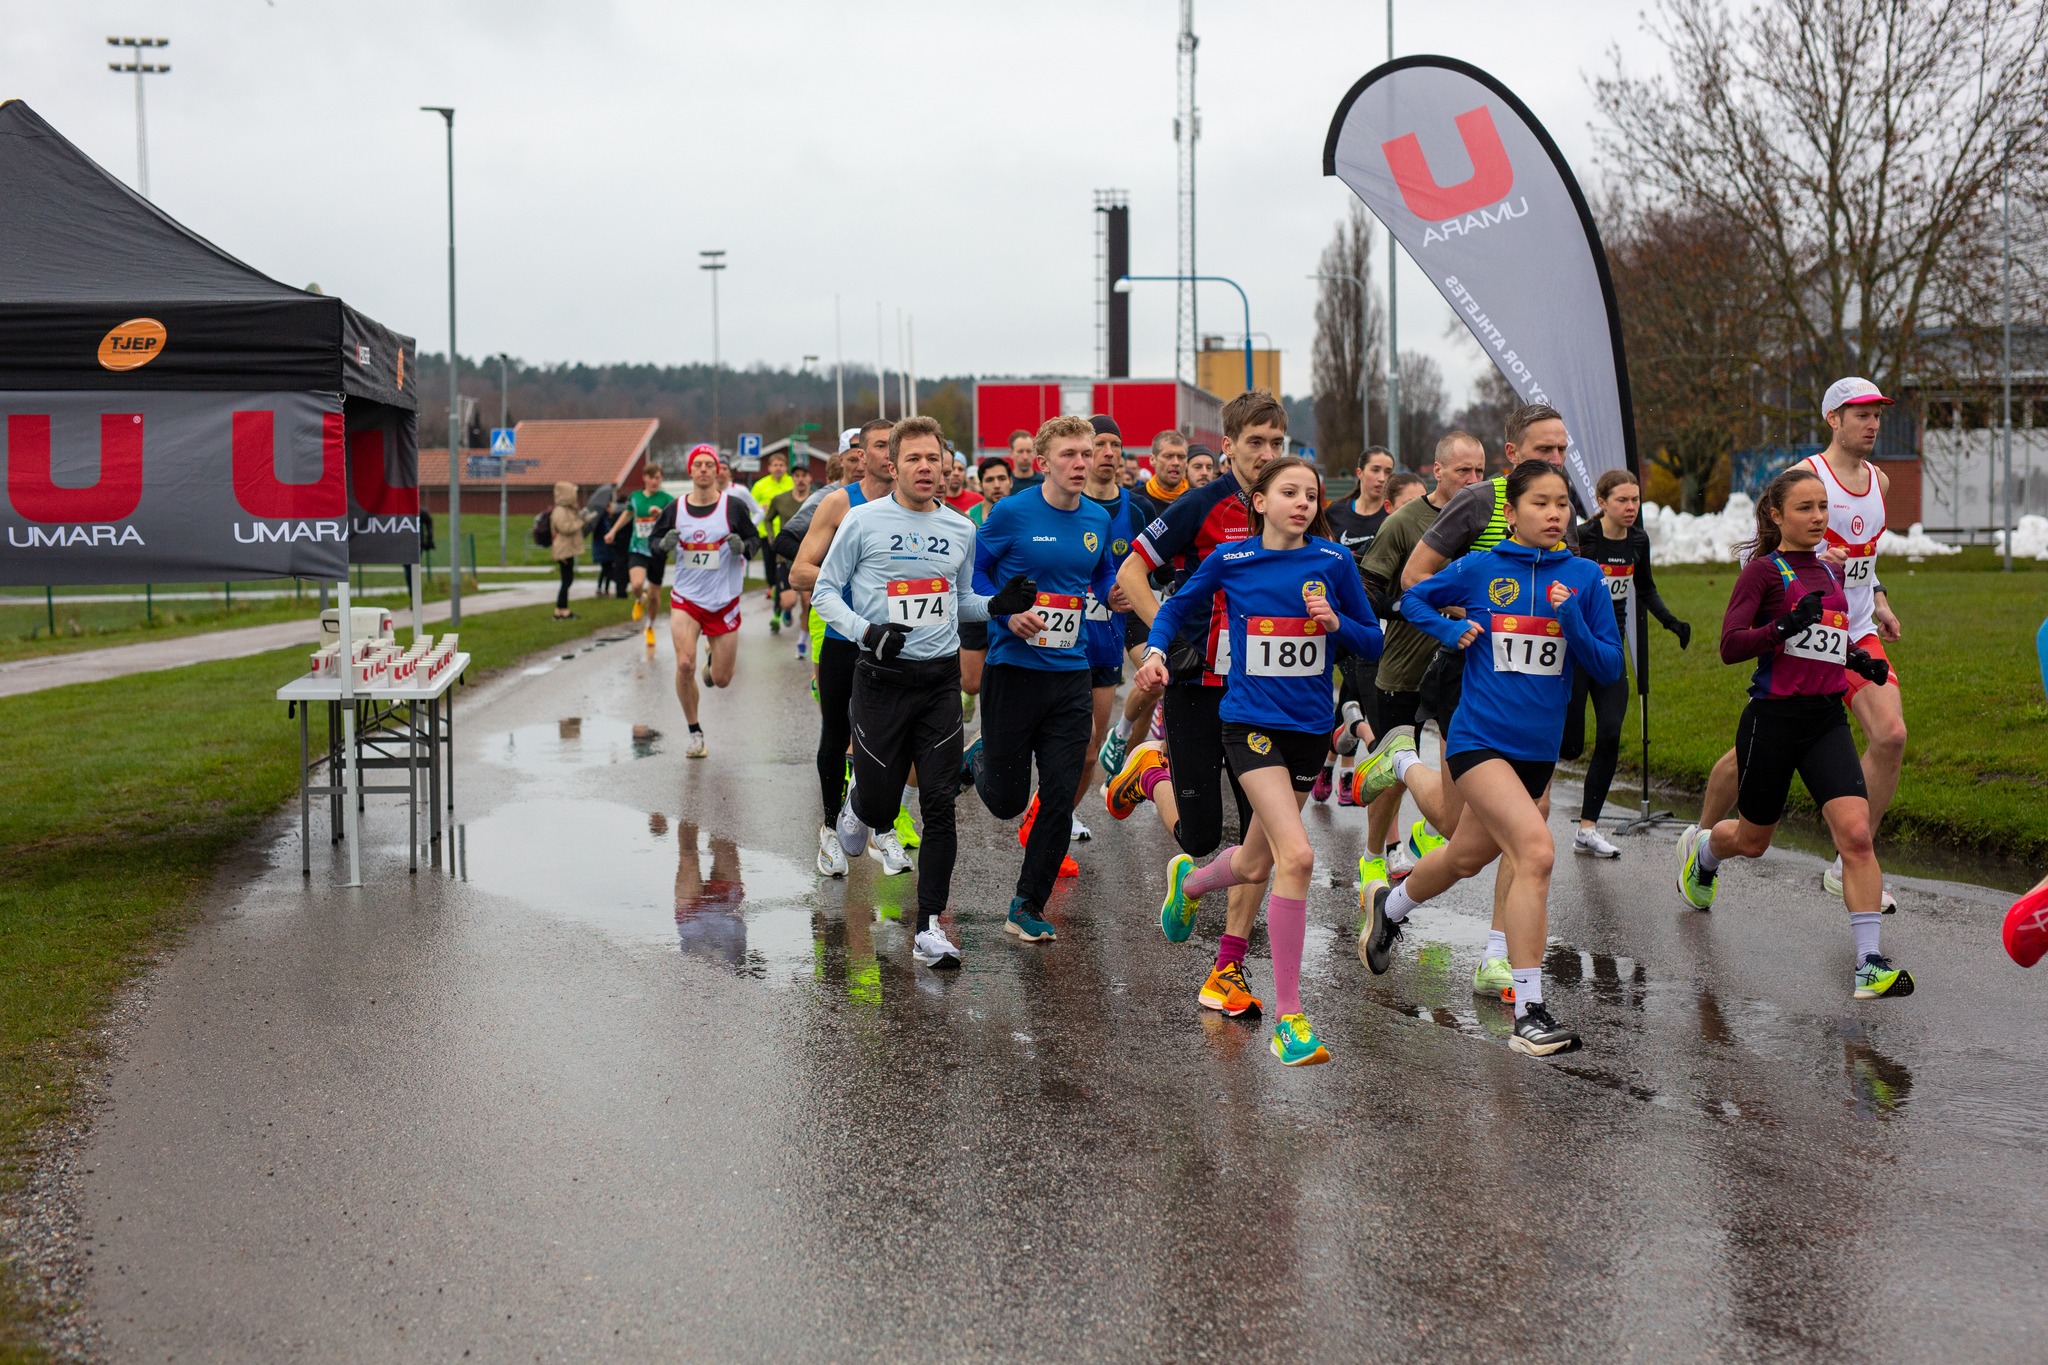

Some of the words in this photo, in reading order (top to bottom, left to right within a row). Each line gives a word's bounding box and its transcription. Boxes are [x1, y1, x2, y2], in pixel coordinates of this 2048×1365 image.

[111, 336, 157, 350] TJEP
[353, 516, 421, 534] UMA
[1854, 521, 1862, 531] FIF
[8, 525, 146, 547] UMARA
[692, 553, 710, 565] 47
[1222, 550, 1255, 561] stadium
[1320, 547, 1339, 557] CRAFT
[1842, 561, 1870, 580] 45
[1607, 578, 1630, 595] 05
[899, 597, 943, 620] 174
[1060, 640, 1071, 648] 226
[1795, 628, 1841, 655] 232
[1260, 641, 1318, 668] 180
[1502, 638, 1558, 667] 118
